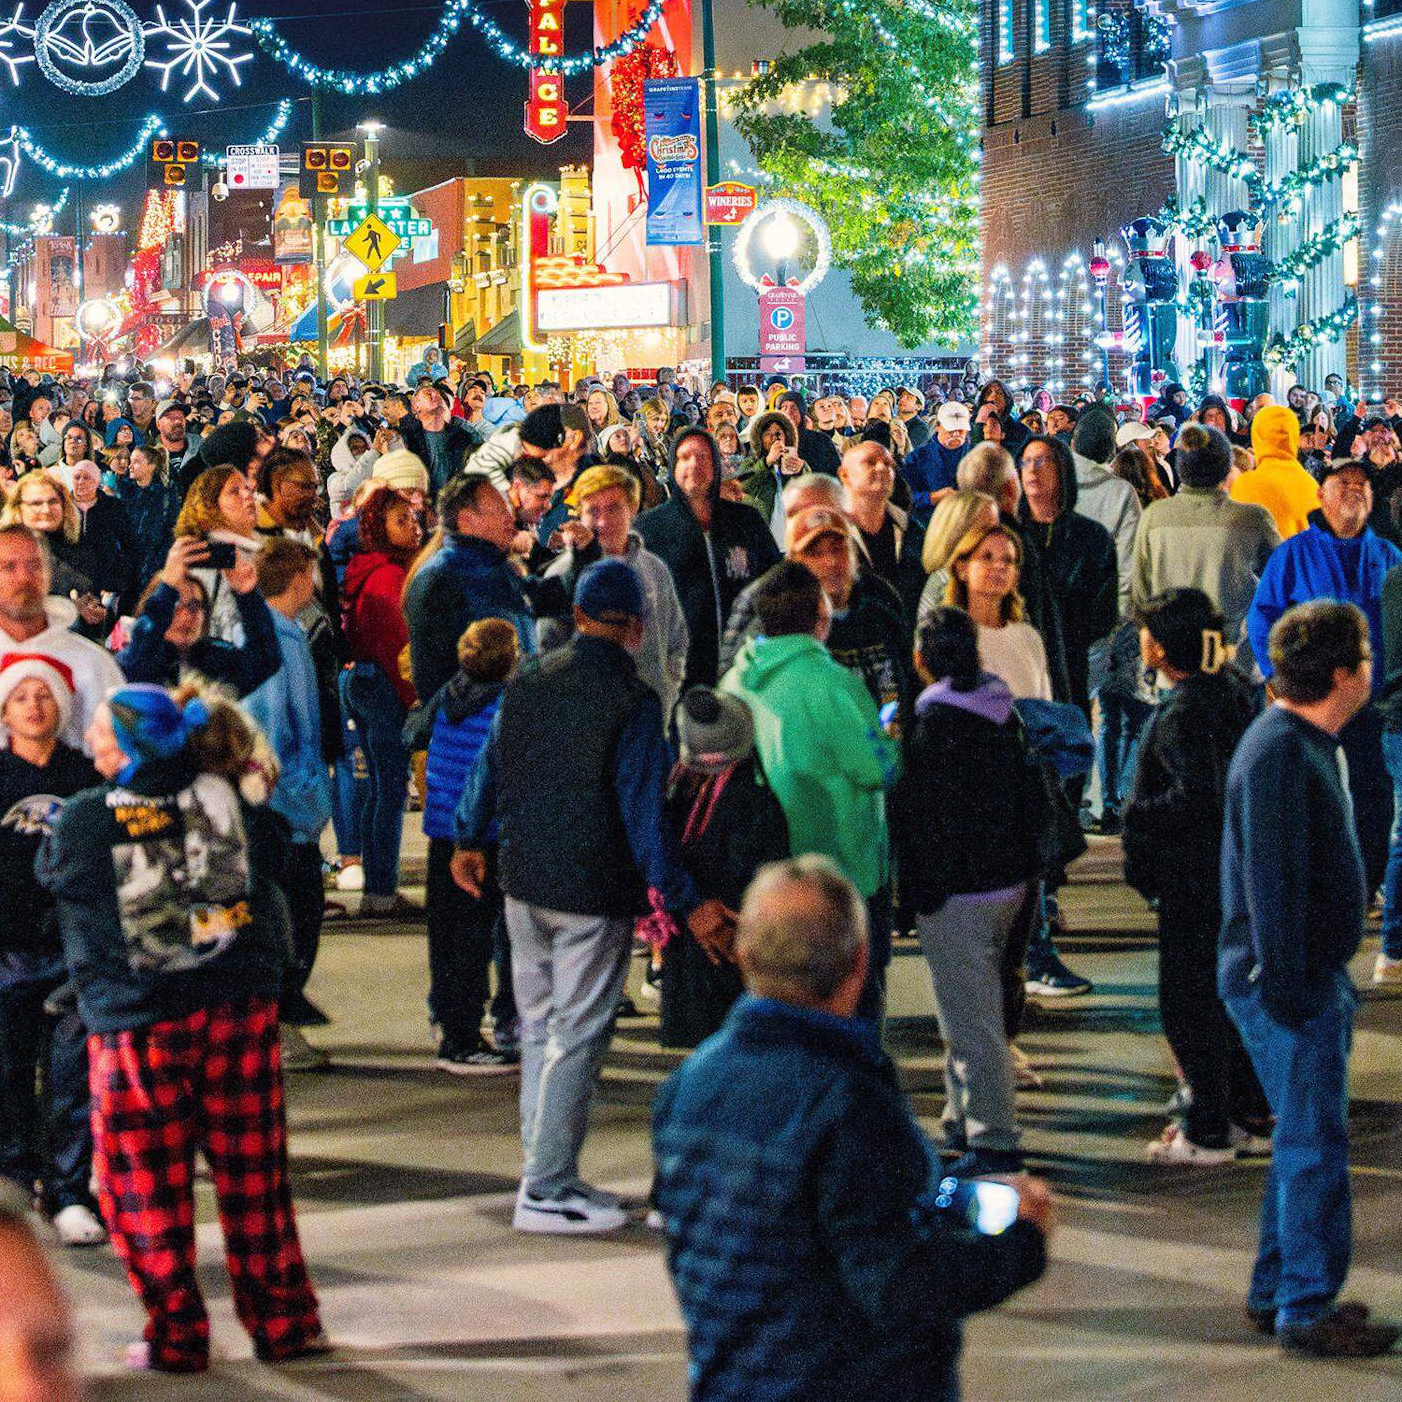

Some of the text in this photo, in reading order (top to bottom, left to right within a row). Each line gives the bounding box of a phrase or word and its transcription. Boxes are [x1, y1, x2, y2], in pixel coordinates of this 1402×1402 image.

[230, 147, 275, 155] CROSSWALK
[708, 196, 752, 207] WINERIES
[246, 272, 281, 283] EPAIR
[776, 310, 789, 327] P
[765, 343, 799, 351] PARKING
[34, 356, 56, 369] REC
